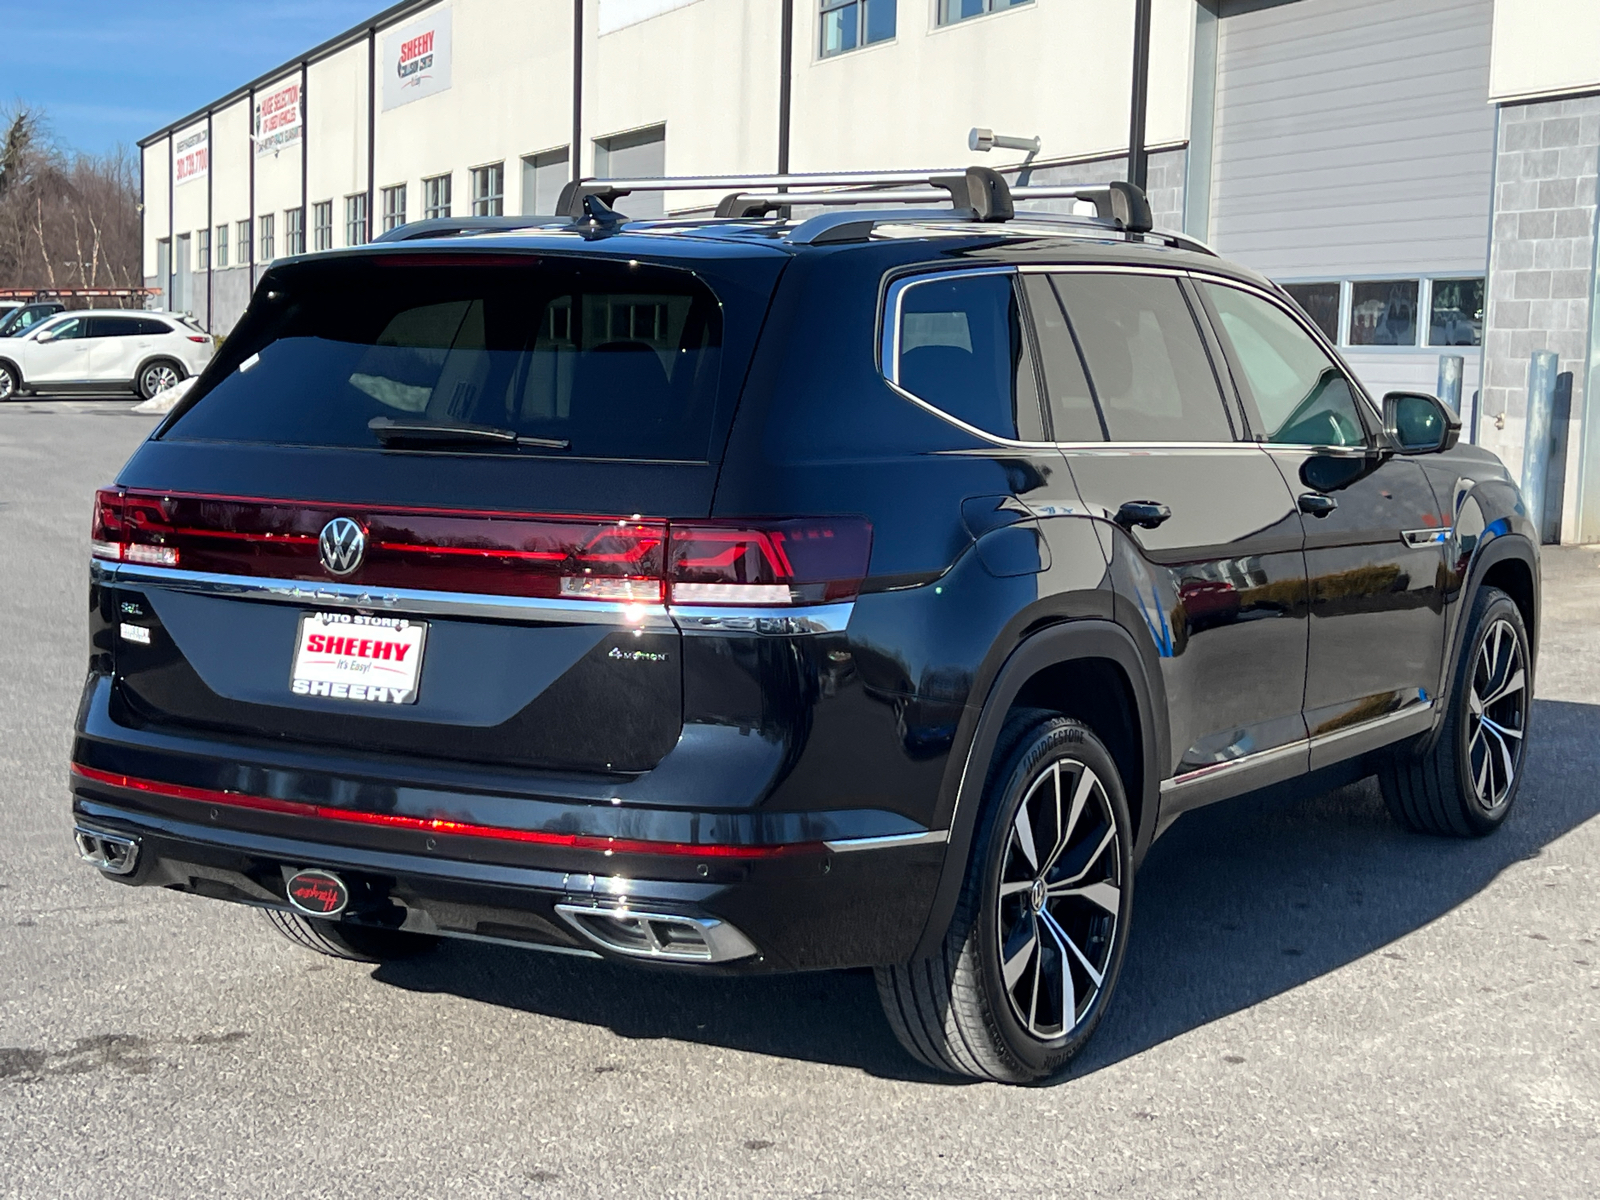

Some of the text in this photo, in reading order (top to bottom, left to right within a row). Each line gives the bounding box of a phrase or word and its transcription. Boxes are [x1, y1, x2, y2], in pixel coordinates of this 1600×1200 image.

[401, 30, 435, 63] SHEEHY
[314, 612, 352, 623] AUTO
[307, 634, 412, 662] SHEEHY
[337, 659, 372, 674] It's Easy!
[292, 679, 411, 704] SHEEHY
